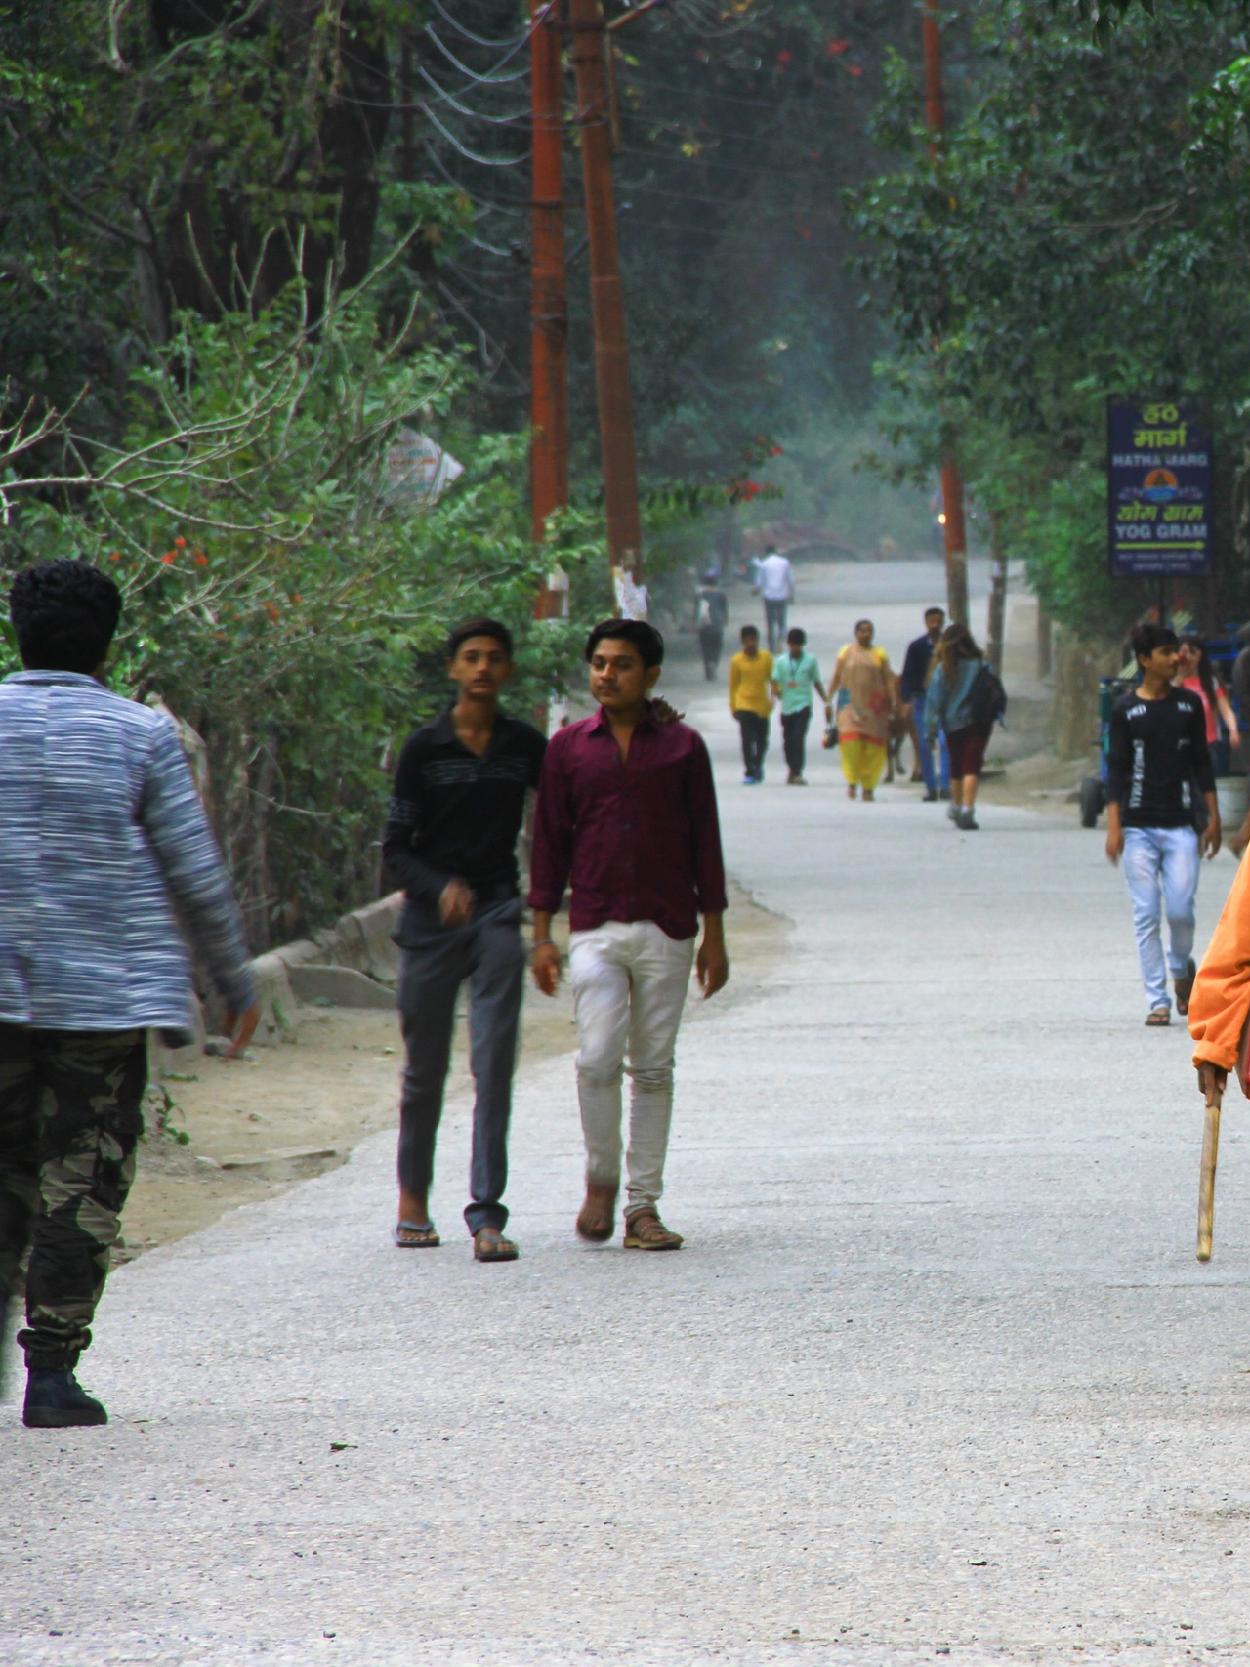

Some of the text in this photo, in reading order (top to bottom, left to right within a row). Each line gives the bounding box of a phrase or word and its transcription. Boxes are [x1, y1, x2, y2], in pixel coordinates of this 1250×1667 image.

[1133, 421, 1188, 449] मार्ग
[1115, 523, 1207, 539] YOG GRAM
